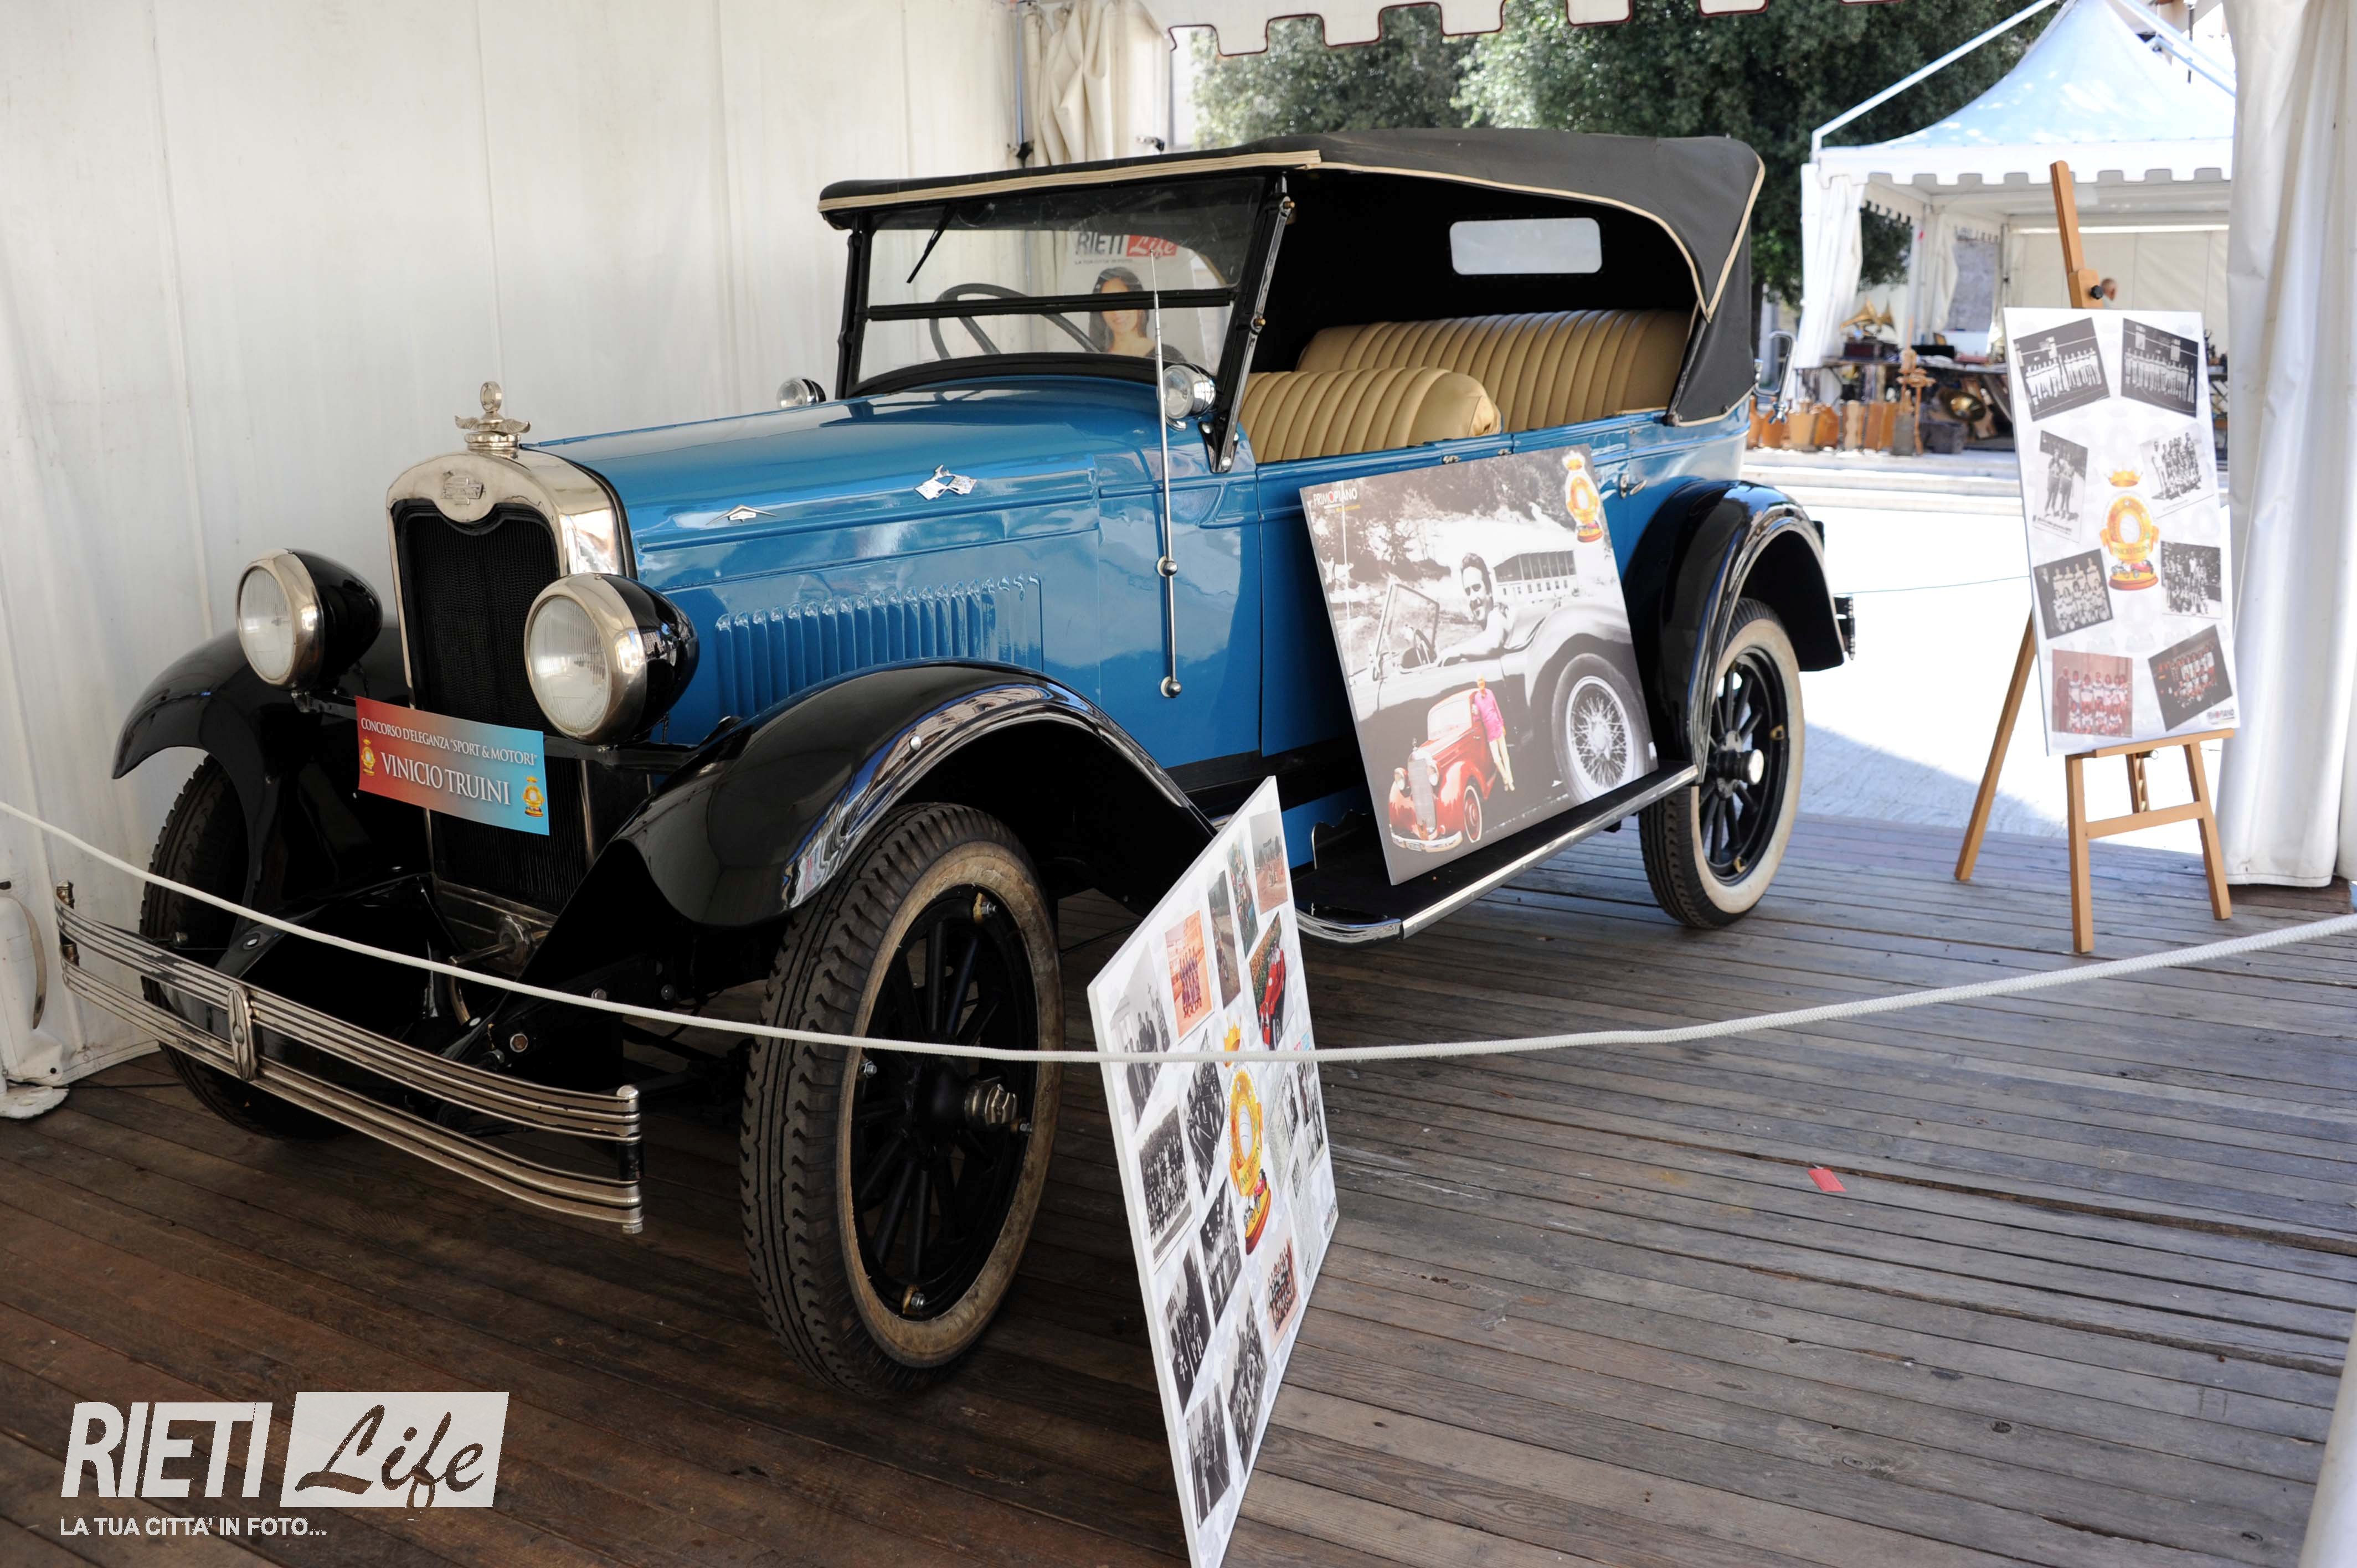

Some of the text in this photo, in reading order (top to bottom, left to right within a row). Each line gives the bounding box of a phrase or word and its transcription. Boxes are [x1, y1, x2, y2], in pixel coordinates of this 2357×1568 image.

[1313, 488, 1358, 505] PRIMOPIANO
[361, 718, 402, 739] CONCORSO
[403, 728, 450, 750] D'ELEGANZA
[482, 745, 490, 757] &
[380, 752, 511, 806] VINICIO TRUINI
